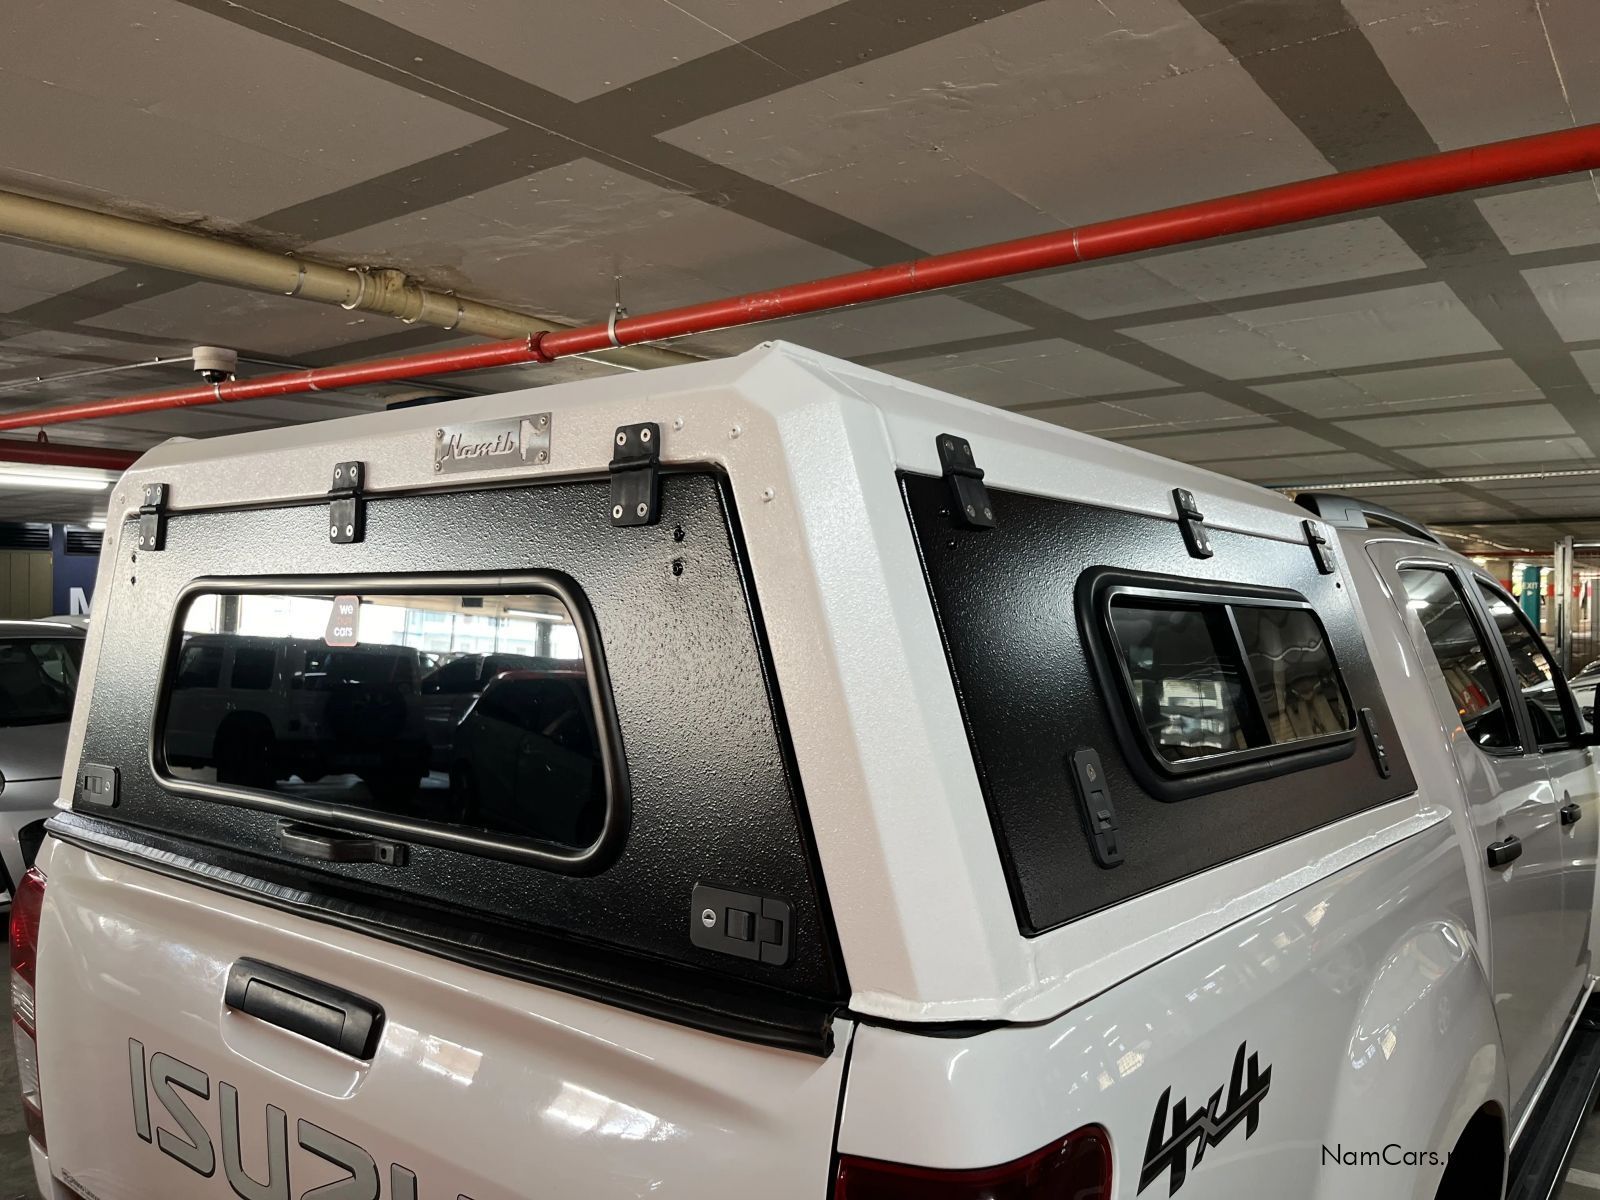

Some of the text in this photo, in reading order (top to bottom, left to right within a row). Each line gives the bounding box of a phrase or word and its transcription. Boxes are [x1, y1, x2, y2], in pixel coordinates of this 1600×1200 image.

[441, 432, 514, 460] Namib
[339, 604, 354, 615] we
[334, 627, 353, 637] cars
[128, 1037, 476, 1200] ISUZ
